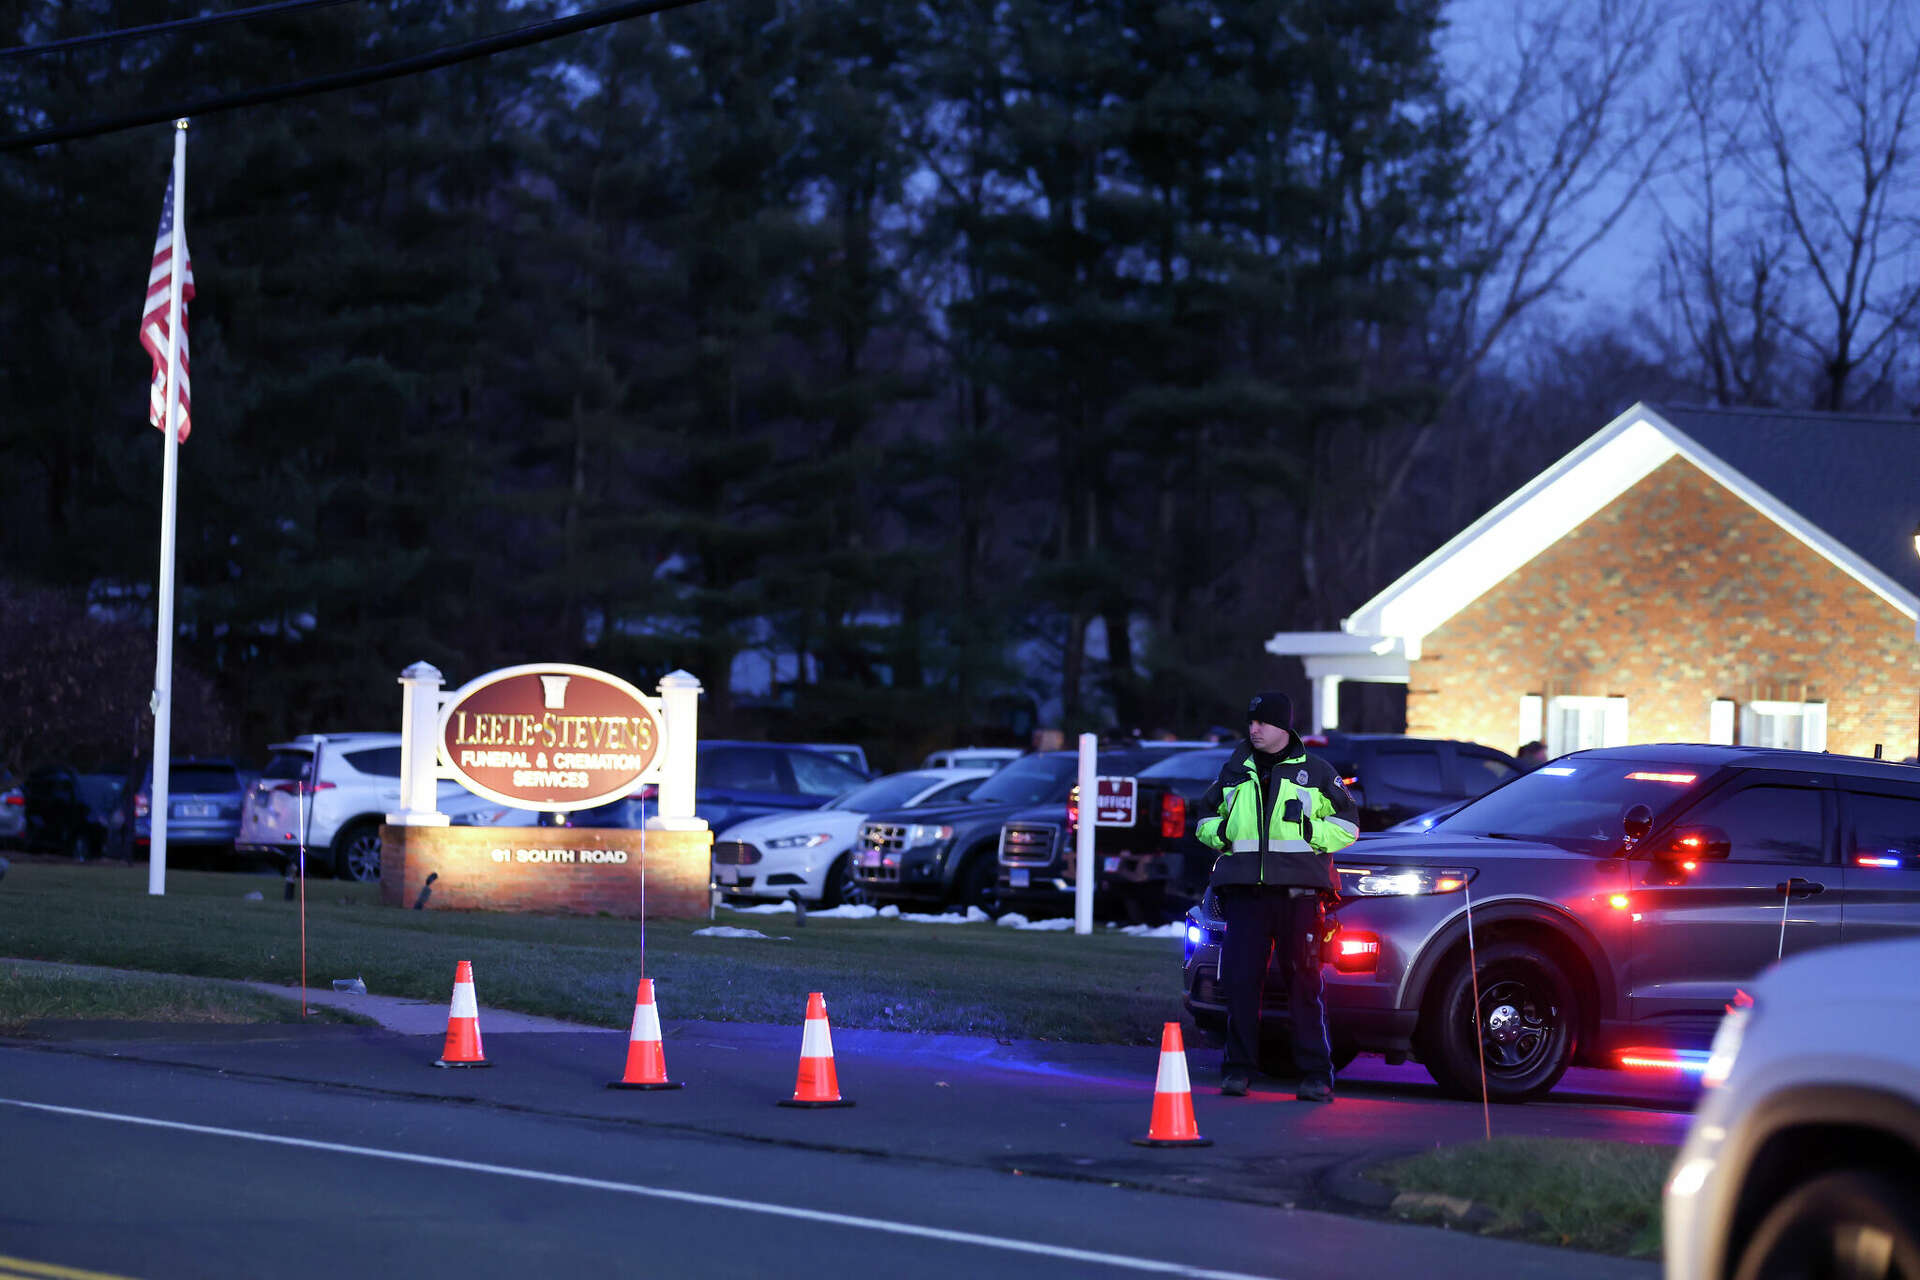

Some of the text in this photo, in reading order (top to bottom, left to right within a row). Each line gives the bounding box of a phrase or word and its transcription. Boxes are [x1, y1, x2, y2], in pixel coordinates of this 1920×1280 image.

[461, 751, 641, 771] FUNERAL & CREMATION
[513, 770, 589, 788] SERVICES
[1097, 795, 1131, 809] OFFICE
[516, 849, 575, 863] SOUTH
[580, 850, 628, 864] ROAD
